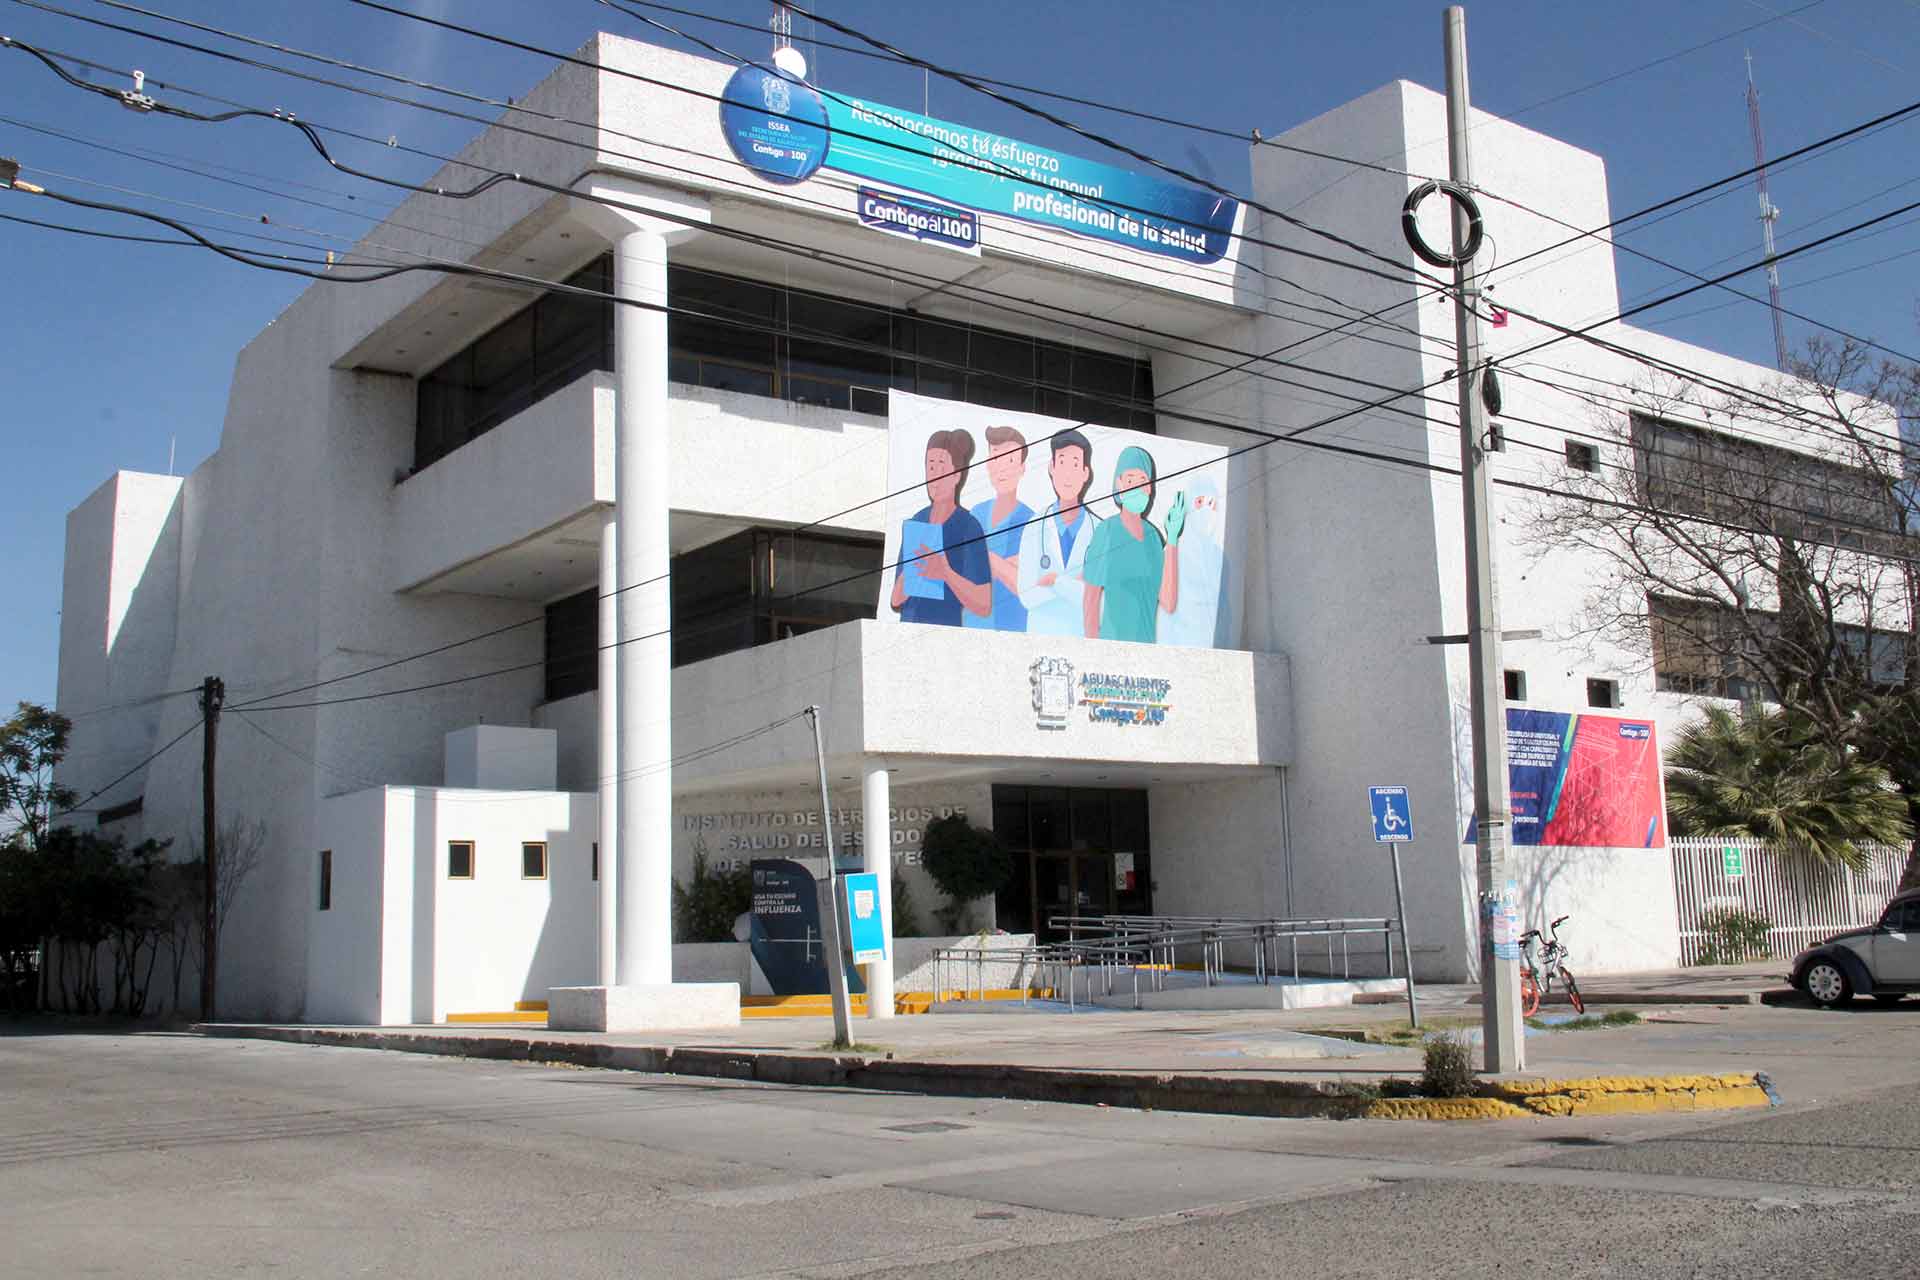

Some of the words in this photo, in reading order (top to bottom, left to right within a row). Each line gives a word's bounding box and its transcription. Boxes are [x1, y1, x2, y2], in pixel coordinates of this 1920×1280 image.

[768, 121, 790, 132] ISSEA
[851, 100, 968, 149] Reconocemos
[992, 142, 1060, 172] esfuerzo
[753, 144, 783, 158] Contigo
[791, 150, 807, 160] 100
[1013, 190, 1114, 232] profesional
[1118, 212, 1139, 237] de
[1143, 219, 1159, 242] la
[1161, 228, 1206, 253] salud
[1081, 672, 1171, 690] AGUASCALIENTES
[793, 811, 819, 826] DE
[728, 833, 790, 849] SALUD
[841, 829, 921, 846] ESDO
[754, 905, 802, 914] INFLUENZA
